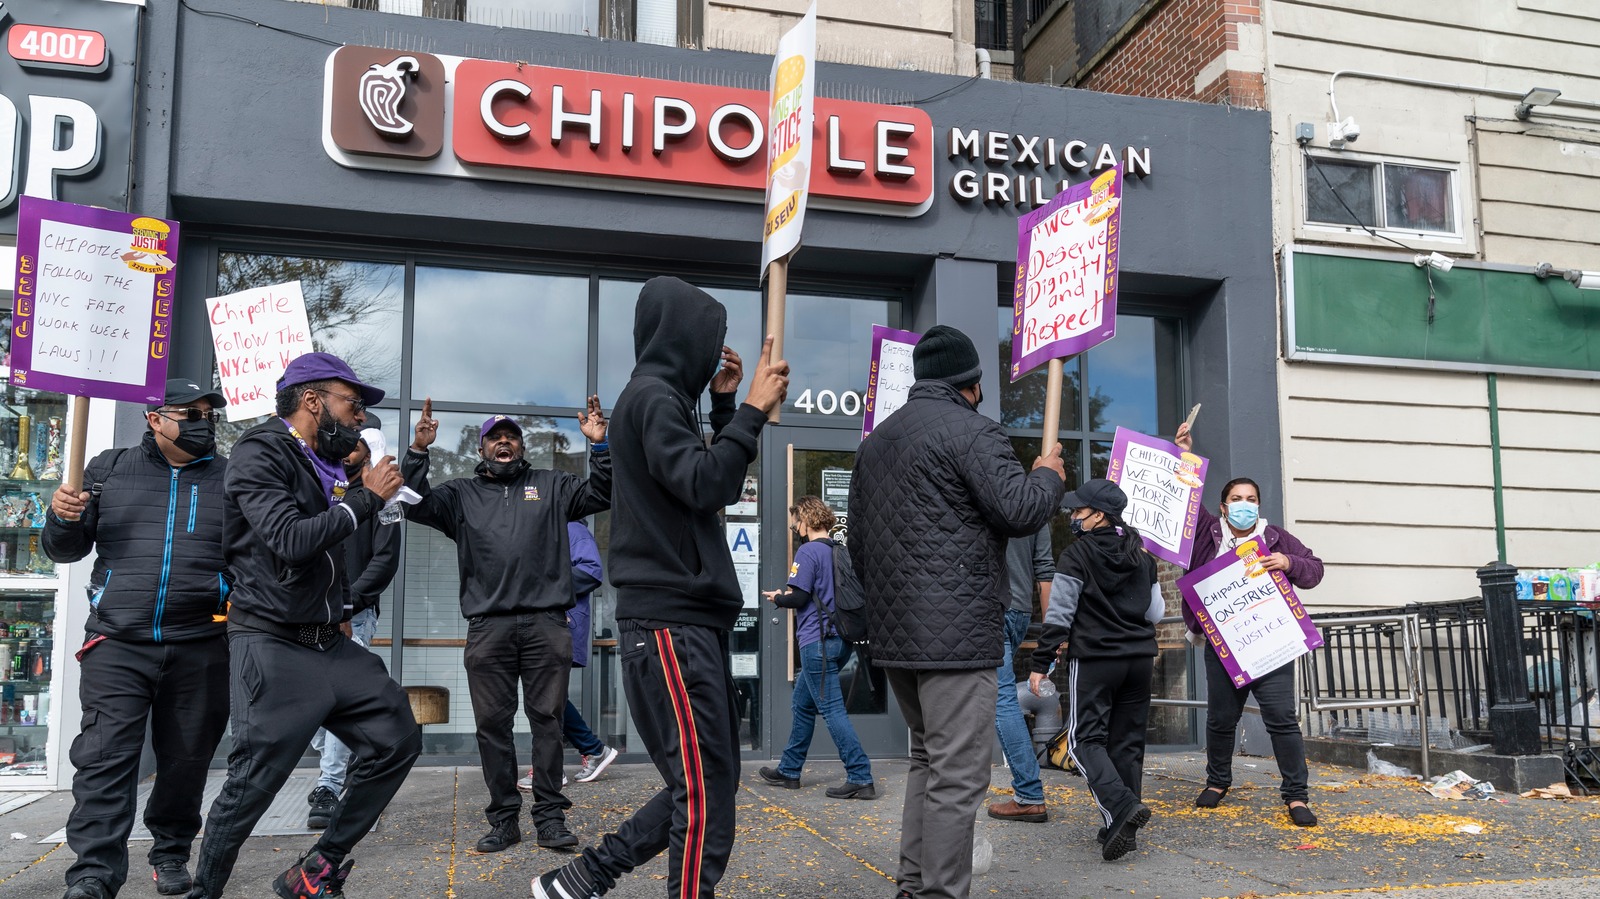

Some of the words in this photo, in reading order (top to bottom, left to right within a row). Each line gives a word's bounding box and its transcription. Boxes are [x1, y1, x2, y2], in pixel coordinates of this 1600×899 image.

[20, 30, 94, 61] 4007
[479, 79, 915, 180] CHIPOLE
[772, 105, 802, 164] STICE
[0, 94, 98, 207] P
[951, 127, 1151, 176] MEXICAN
[774, 194, 796, 231] SEIU
[44, 233, 120, 260] CHIPOTLE
[1028, 230, 1108, 281] Deserve
[42, 263, 94, 283] FOLLOW
[104, 274, 134, 291] THE
[1026, 254, 1101, 309] Dignity
[15, 254, 35, 338] 32BJ
[39, 291, 70, 308] NYC
[84, 298, 125, 315] FAIR
[1049, 278, 1085, 308] and
[150, 279, 172, 359] SEIU
[211, 293, 293, 325] Chipotle
[1024, 289, 1104, 352] Respect
[38, 316, 79, 331] WORK
[90, 324, 130, 339] WEEK
[275, 325, 306, 344] The
[881, 360, 895, 370] WE
[882, 343, 913, 358] CHIPOTL
[220, 355, 250, 378] NYC
[225, 385, 268, 406] Week
[794, 389, 867, 416] 400
[1129, 447, 1180, 473] CHIPOTLE
[1126, 464, 1152, 482] WE
[1156, 473, 1185, 498] WANT
[1132, 484, 1172, 510] MORE
[732, 528, 753, 552] A
[1203, 576, 1249, 607] CHIPOTLE
[1215, 604, 1234, 623] ON
[1233, 582, 1277, 611] STRIKE
[1233, 613, 1263, 633] FOR
[1235, 616, 1290, 652] JUSTICE
